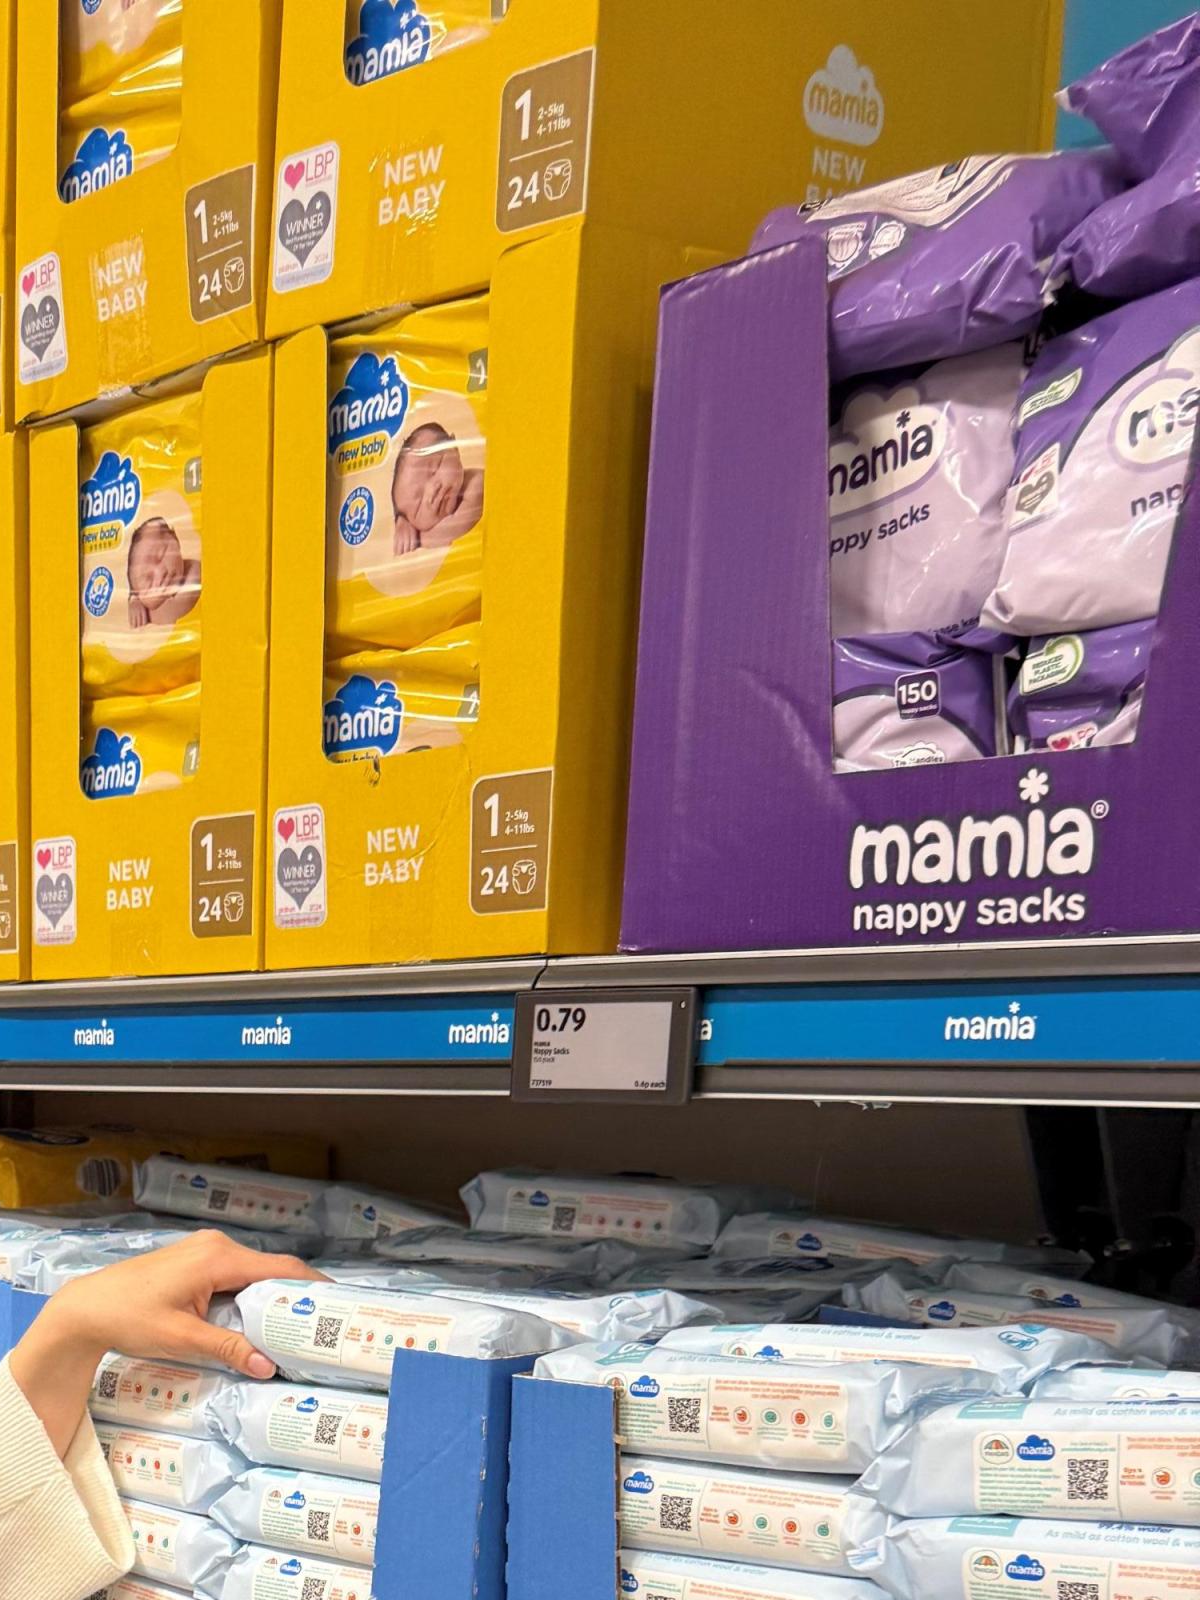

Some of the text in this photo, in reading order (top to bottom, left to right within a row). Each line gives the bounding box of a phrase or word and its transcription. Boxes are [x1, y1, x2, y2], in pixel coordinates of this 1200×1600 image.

[514, 89, 532, 141] 1
[536, 102, 565, 122] 2-5kg
[808, 81, 879, 127] mamia
[536, 116, 572, 137] 4-11lbs
[304, 150, 335, 182] LBP
[383, 144, 444, 189] NEW
[812, 147, 866, 182] NEW
[377, 181, 445, 227] BABY
[507, 171, 540, 212] 24
[193, 199, 209, 245] 1
[212, 209, 233, 227] 2-5kg
[212, 222, 240, 240] 4-11lbs
[285, 212, 325, 237] WINNER
[35, 260, 56, 288] LBP
[96, 250, 145, 291] NEW
[197, 269, 223, 304] 24
[97, 280, 148, 322] BABY
[24, 314, 55, 337] WINNER
[329, 371, 402, 435] mamia
[337, 438, 385, 463] new baby
[1032, 654, 1064, 670] REDUCED
[1033, 662, 1063, 677] PLASTIC
[1028, 667, 1069, 686] PACKAGING
[898, 680, 938, 705] 150
[82, 742, 138, 793] mamia
[294, 813, 320, 839] LBP
[483, 792, 500, 838] 1
[504, 809, 530, 825] 2-5kg
[366, 824, 421, 855] NEW
[504, 822, 536, 837] 4-11lbs
[51, 845, 73, 867] LBP
[199, 832, 213, 872] 1
[108, 857, 151, 883] NEW
[282, 863, 317, 880] WINNER
[363, 856, 425, 888] BABY
[479, 865, 510, 896] 24
[105, 885, 154, 912] BABY
[198, 895, 222, 923] 24
[853, 886, 1087, 936] nappy sacks
[73, 1018, 115, 1046] mamia
[241, 1016, 291, 1046] mamia
[447, 1012, 511, 1045] mamia
[536, 1007, 587, 1033] 0.79
[945, 1001, 1037, 1041] mamia
[533, 1047, 570, 1056] Nappy Sacks
[631, 1380, 660, 1396] mamia
[1054, 1407, 1067, 1416] As
[1069, 1407, 1094, 1416] mild
[1111, 1407, 1148, 1417] cotton
[1150, 1406, 1177, 1417] wool
[1018, 1441, 1054, 1457] mamia
[625, 1475, 655, 1493] mamia
[1046, 1528, 1059, 1538] As
[1062, 1528, 1086, 1540] mild
[1103, 1532, 1140, 1545] cotton
[1142, 1533, 1171, 1546] wool
[1137, 1524, 1174, 1534] water
[1006, 1561, 1043, 1577] mamia
